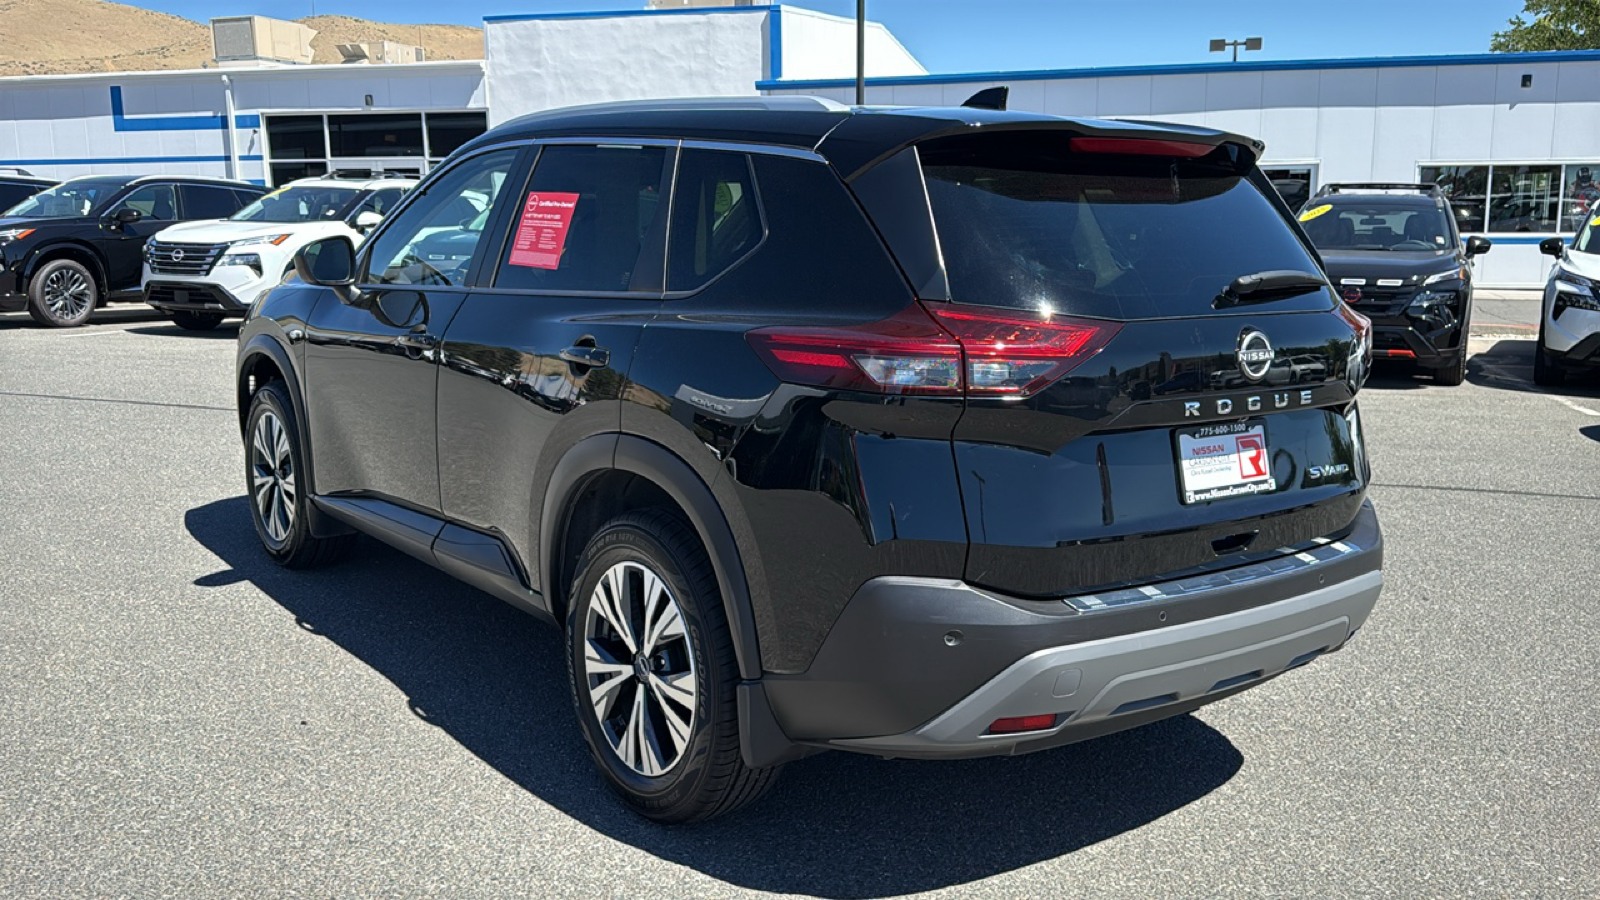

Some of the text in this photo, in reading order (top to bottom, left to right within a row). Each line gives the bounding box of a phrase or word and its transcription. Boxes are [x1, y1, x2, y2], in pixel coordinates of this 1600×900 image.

[1238, 352, 1274, 361] NISSAN
[1184, 390, 1312, 417] ROGUE
[1200, 423, 1246, 436] 775-600-1500
[1192, 445, 1224, 456] NISSAN
[1309, 464, 1330, 479] SV
